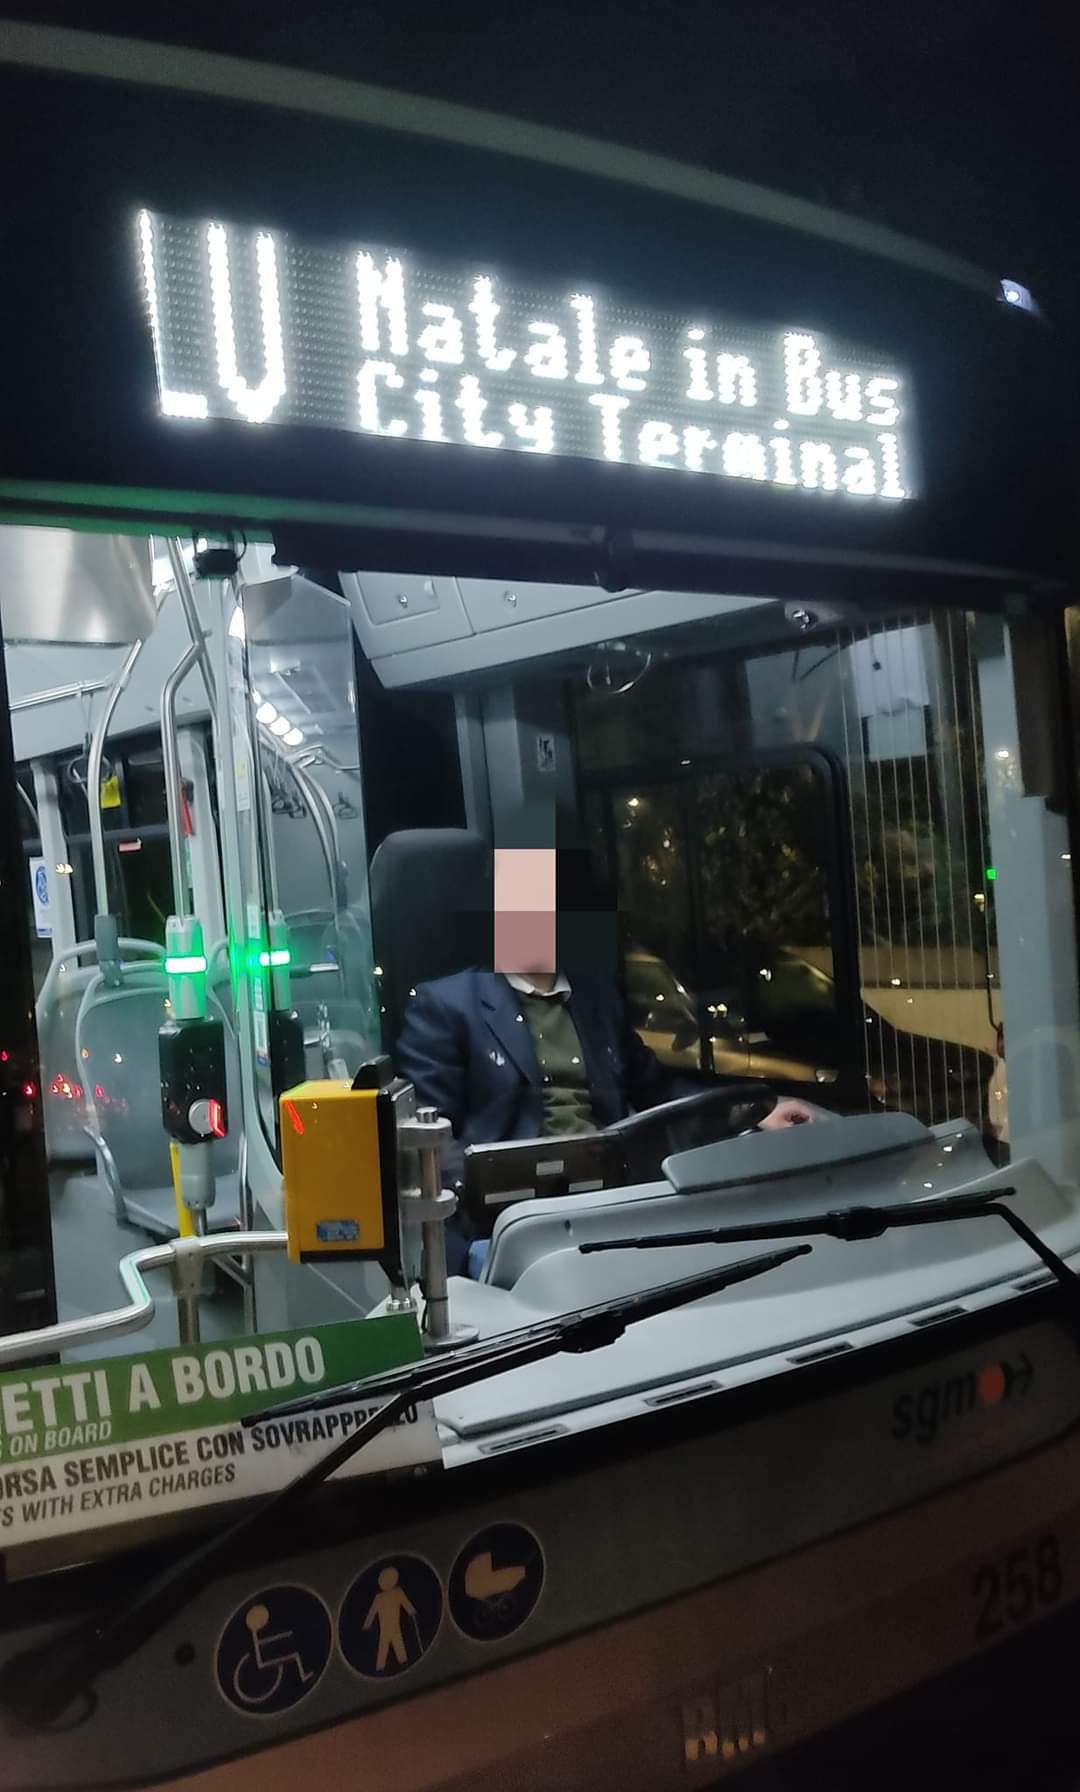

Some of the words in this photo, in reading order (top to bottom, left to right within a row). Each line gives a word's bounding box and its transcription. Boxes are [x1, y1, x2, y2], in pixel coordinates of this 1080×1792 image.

[682, 328, 758, 407] in
[783, 332, 901, 426] Bus
[356, 360, 556, 454] City
[588, 394, 905, 498] Terminal
[128, 1363, 161, 1413] A
[171, 1336, 326, 1404] BORDO
[0, 1464, 57, 1501] RSA
[64, 1441, 189, 1488] SEMPLICE
[198, 1430, 246, 1462] CON
[9, 1432, 39, 1457] ON
[44, 1420, 112, 1451] BOARD
[22, 1493, 74, 1523] WITH
[80, 1481, 143, 1511] EXTRA
[148, 1463, 236, 1499] CHARGES
[972, 1534, 1063, 1641] 258
